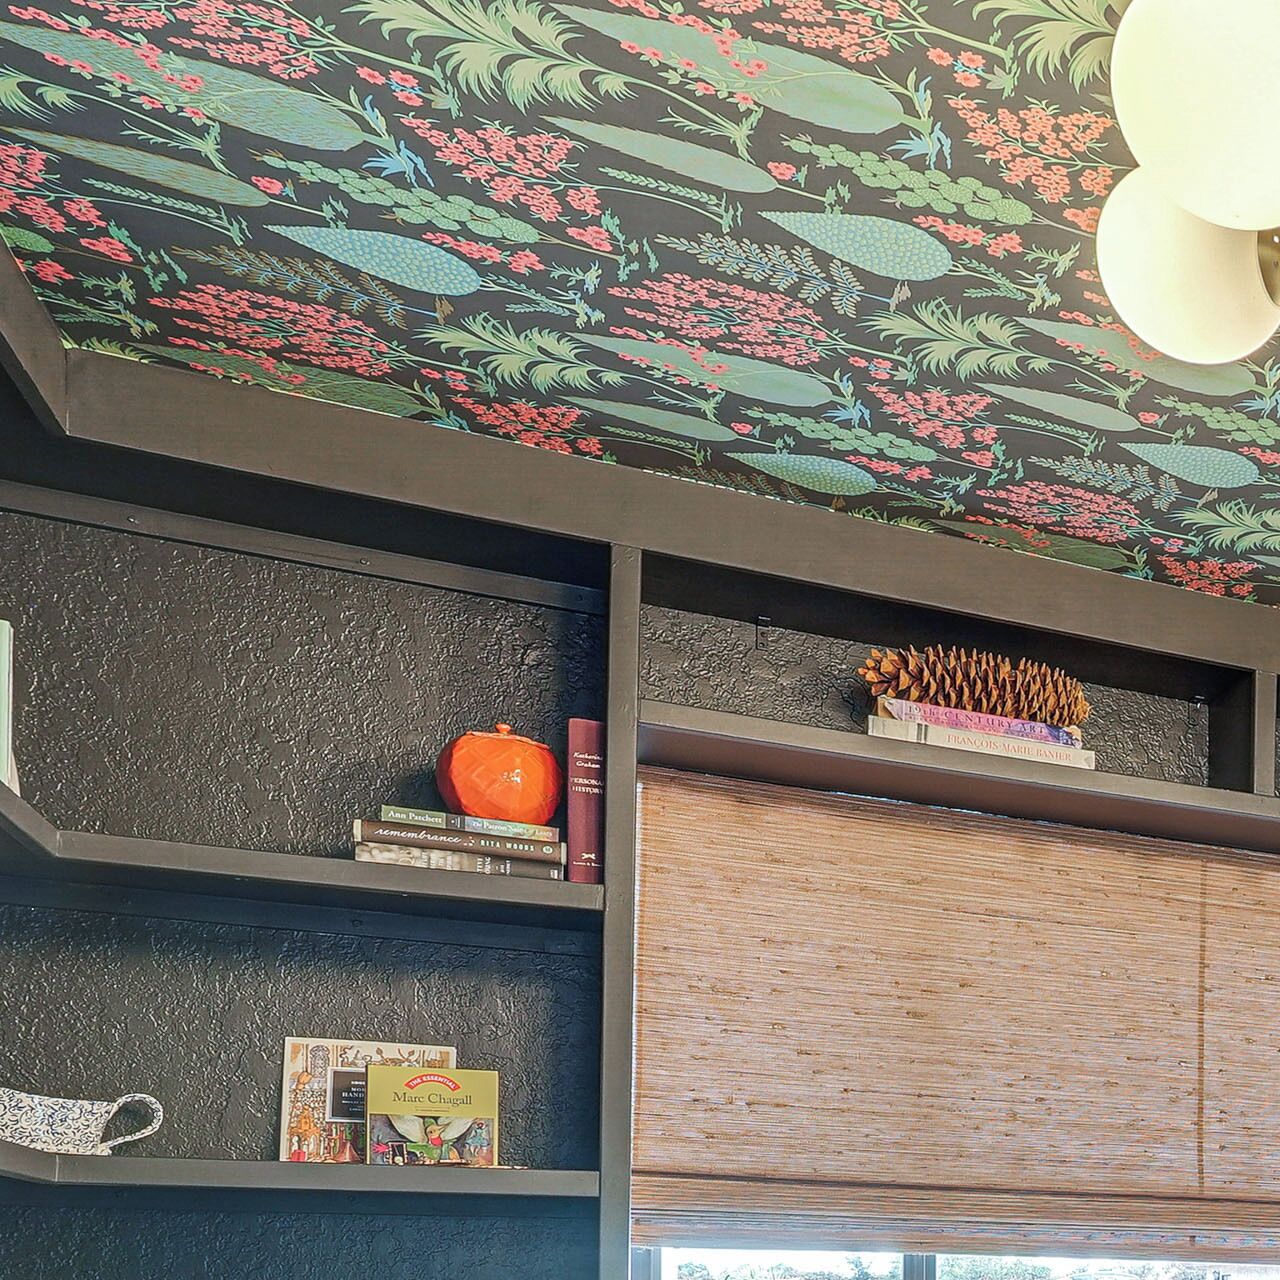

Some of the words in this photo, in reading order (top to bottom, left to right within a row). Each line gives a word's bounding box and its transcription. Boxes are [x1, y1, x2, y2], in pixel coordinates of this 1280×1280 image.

[945, 711, 1014, 729] CENTURY
[1019, 722, 1046, 734] ART
[1036, 749, 1073, 761] BANIER
[575, 761, 601, 769] Graham
[388, 809, 407, 819] Ann
[408, 812, 443, 824] Patchett
[483, 822, 508, 832] Patron
[374, 827, 463, 844] remembrance
[480, 838, 501, 848] RITA
[505, 842, 535, 852] WOODS
[409, 1076, 421, 1088] THE
[422, 1074, 457, 1090] ESSENTIAL
[392, 1092, 424, 1104] Marc
[427, 1092, 473, 1107] Chagall
